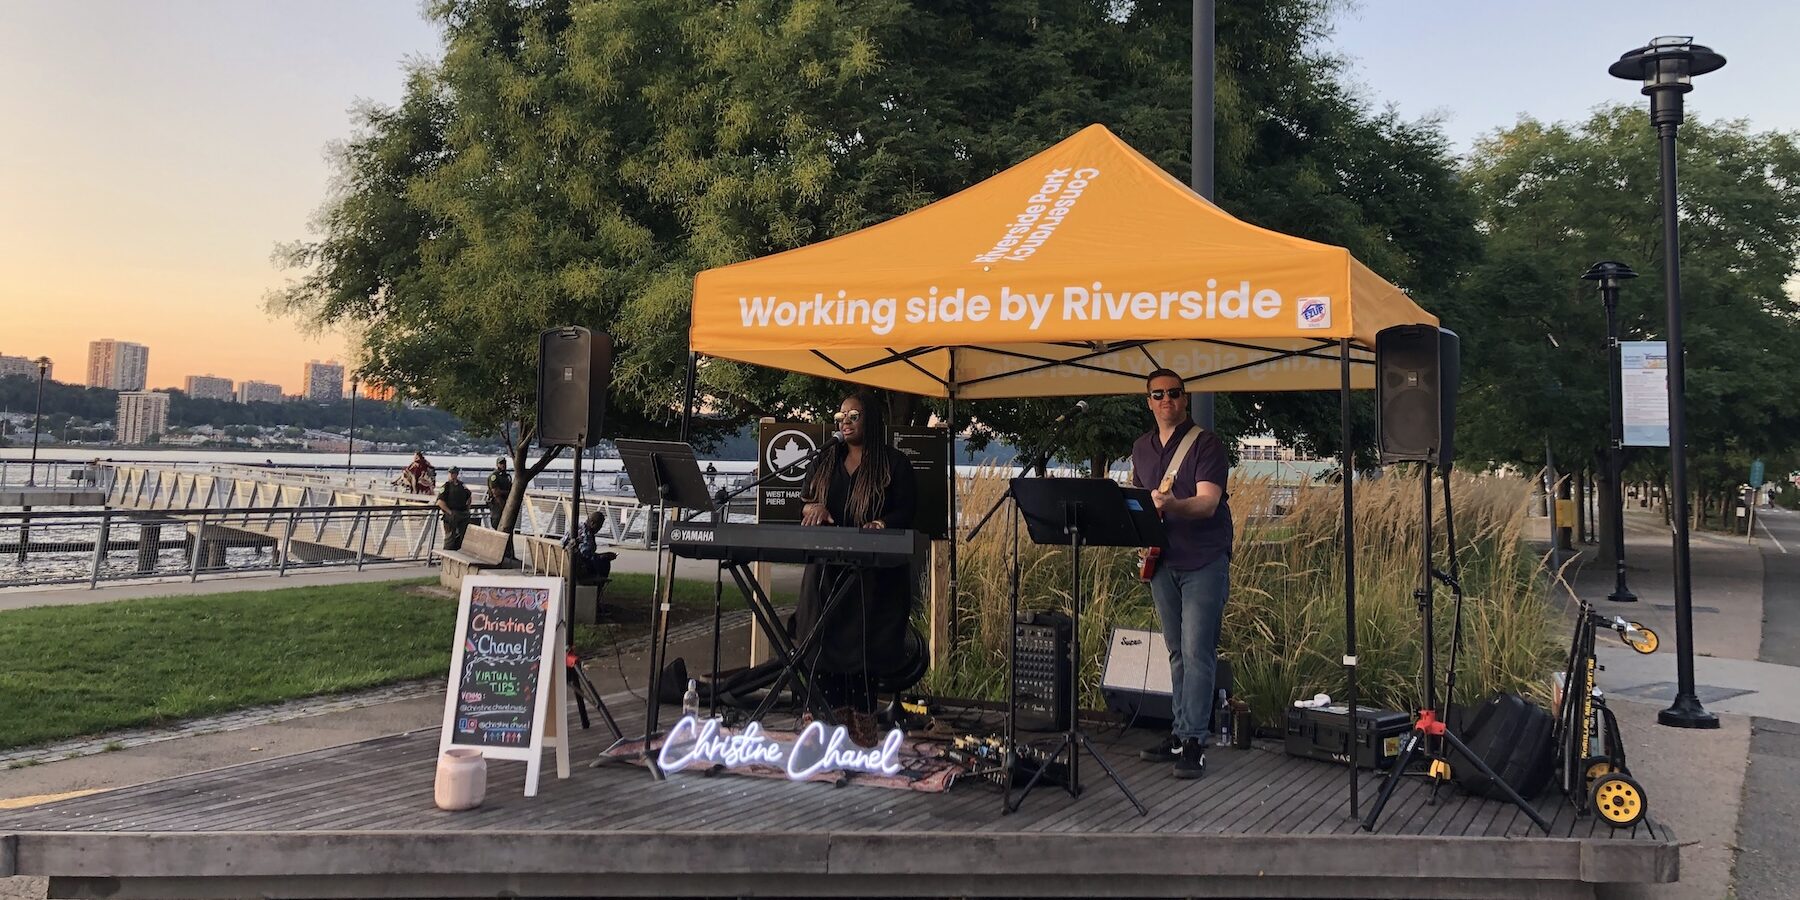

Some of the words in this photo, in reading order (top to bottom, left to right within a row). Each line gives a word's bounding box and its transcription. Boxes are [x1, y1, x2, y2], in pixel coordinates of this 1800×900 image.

[971, 204, 1047, 263] Riverside
[1028, 167, 1072, 203] Park
[1003, 168, 1100, 262] Conservancy
[739, 290, 896, 335] Working
[905, 286, 991, 323] side
[1000, 286, 1054, 330] by
[1063, 278, 1282, 321] Riverside
[766, 490, 785, 498] WEST
[681, 530, 714, 541] YAMAHA
[472, 614, 536, 634] Christine
[478, 634, 527, 655] Chanel
[475, 671, 517, 681] VIRTUAL
[490, 682, 519, 692] TIPS:
[658, 716, 783, 771] Christine
[787, 721, 904, 781] Chanel
